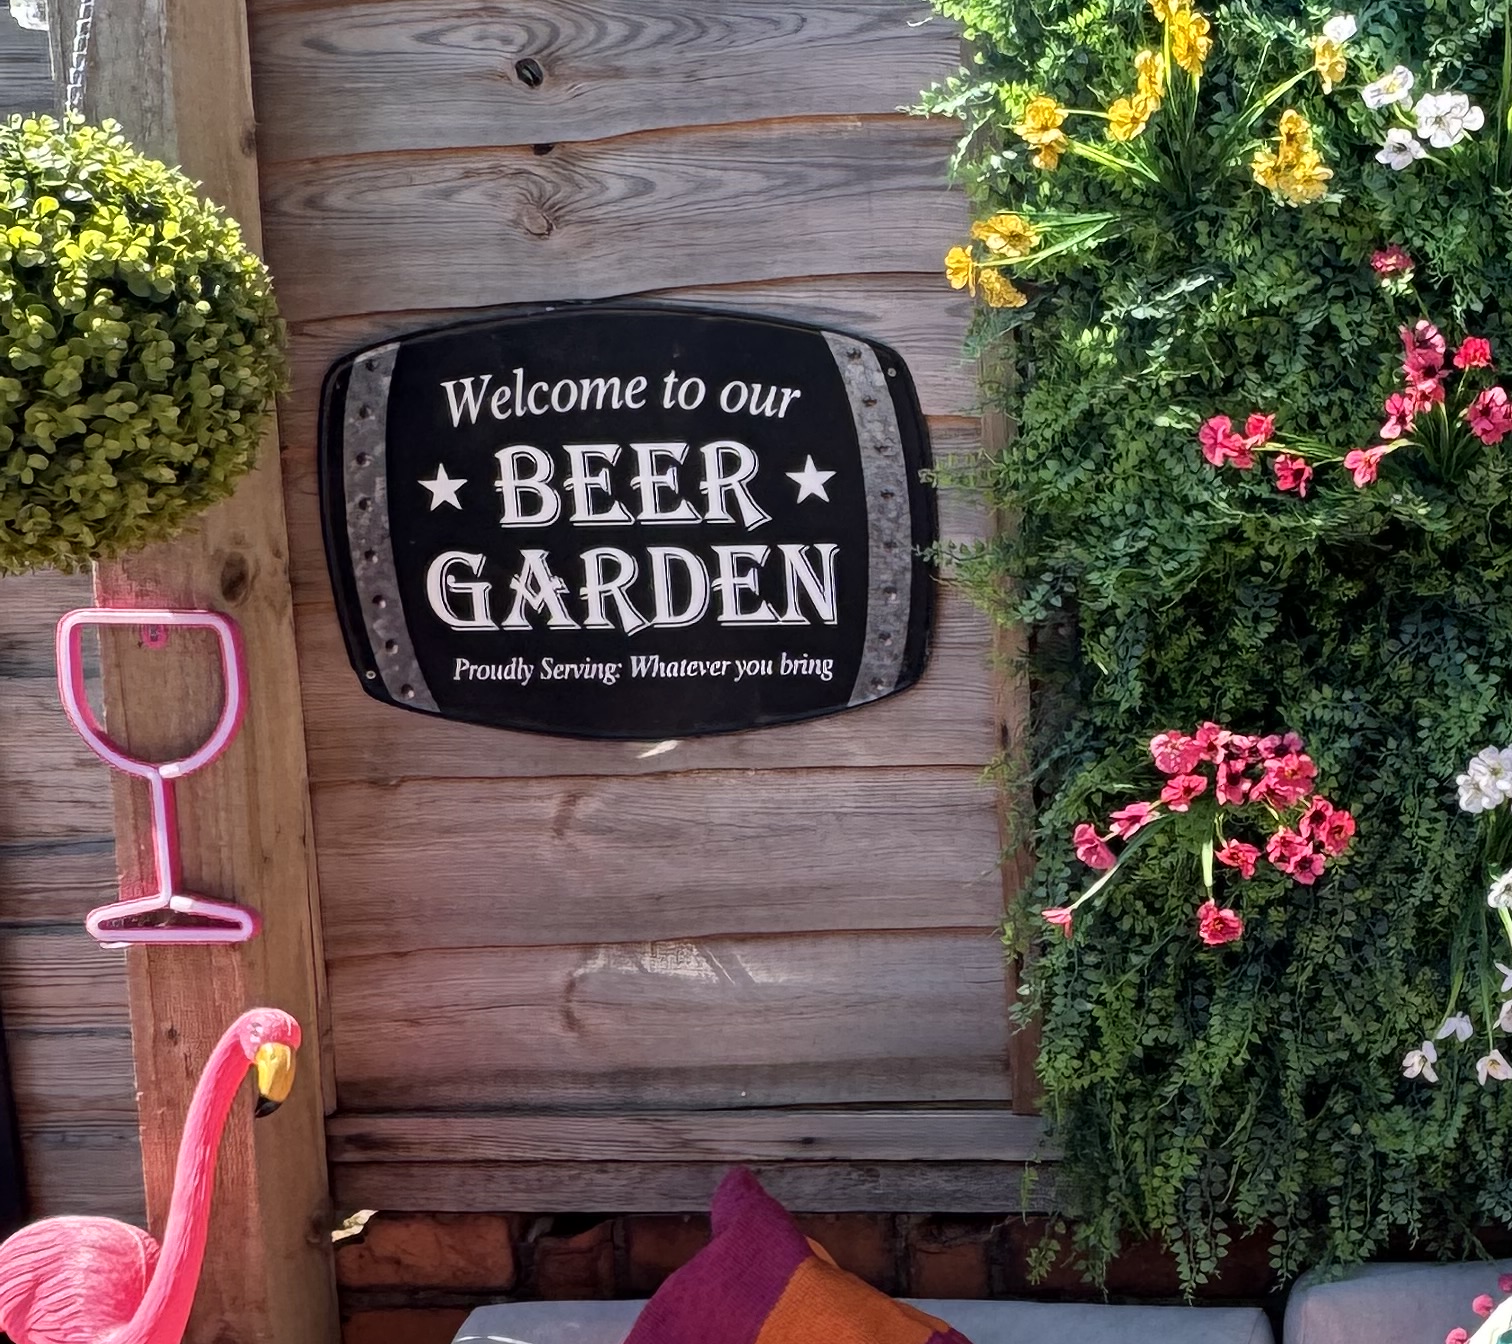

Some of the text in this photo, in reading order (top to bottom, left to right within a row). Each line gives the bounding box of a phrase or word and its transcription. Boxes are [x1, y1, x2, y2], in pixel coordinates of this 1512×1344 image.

[441, 368, 801, 427] Welcome to our
[495, 440, 772, 531] BEER
[426, 542, 840, 637] GARDEN
[453, 652, 834, 686] Proudly Serving: Whatever you bring
